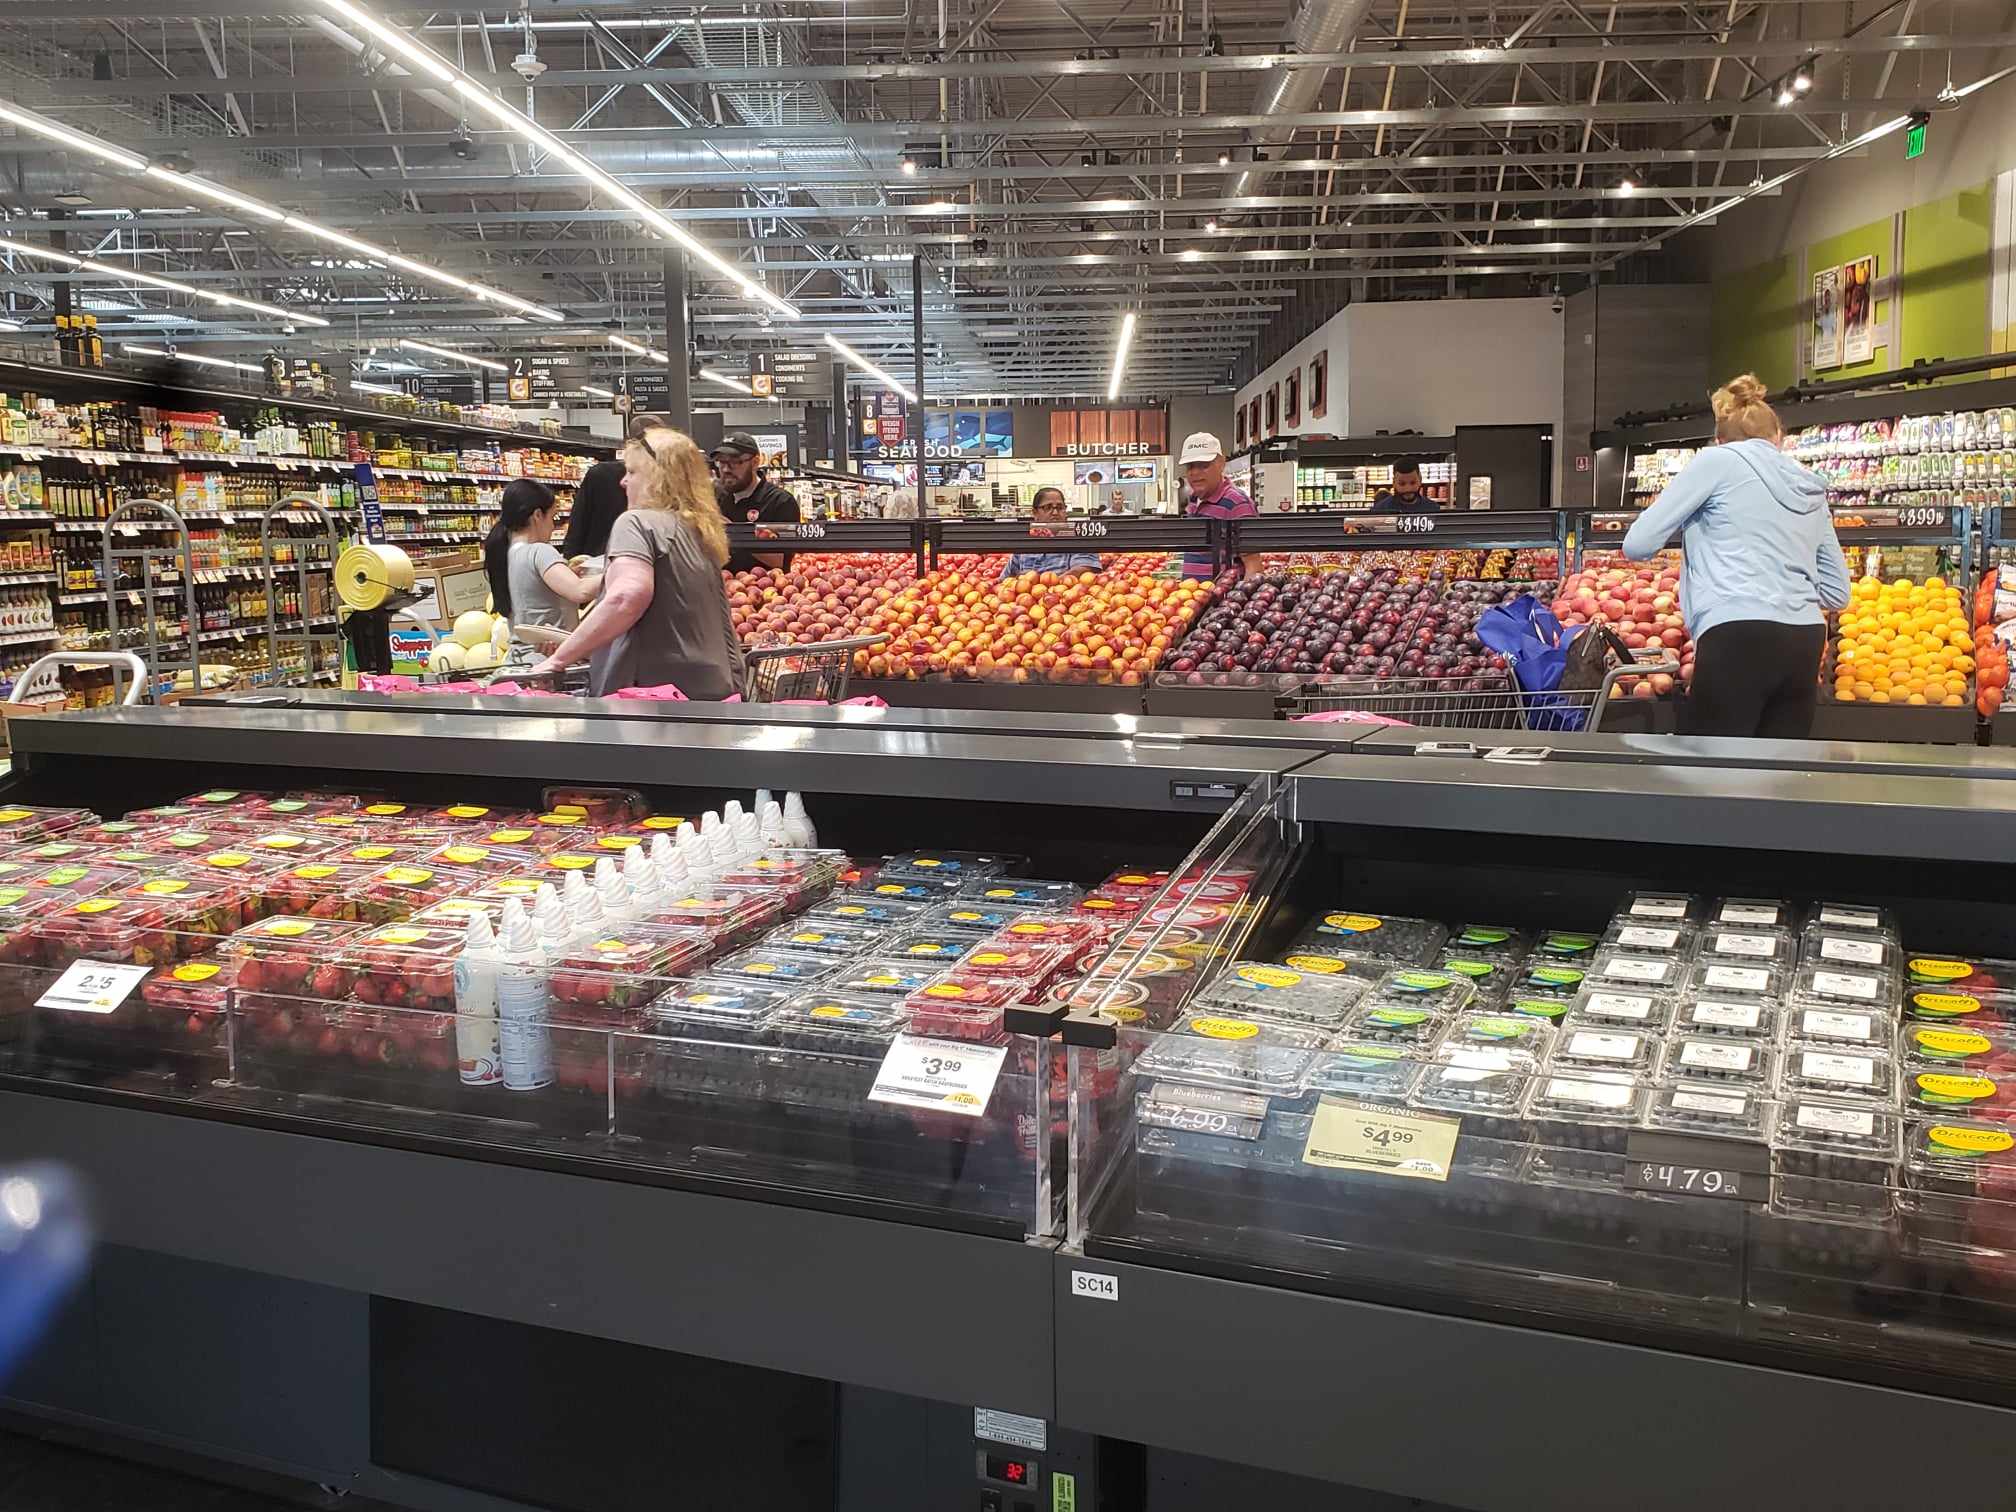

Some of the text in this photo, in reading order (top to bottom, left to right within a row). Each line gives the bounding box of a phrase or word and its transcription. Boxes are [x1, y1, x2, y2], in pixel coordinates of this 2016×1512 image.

[294, 359, 308, 367] SODA
[532, 358, 548, 366] SUGAR
[553, 358, 569, 366] SPICES
[758, 354, 765, 372] 1
[774, 353, 817, 361] SALAD DRESSINGS
[514, 358, 523, 376] 2
[775, 364, 805, 372] CONDIMENTS
[404, 378, 419, 394] 10
[618, 376, 626, 393] 9
[776, 375, 804, 383] COOKING OIL
[866, 404, 873, 418] 8
[903, 439, 938, 447] FRSH
[1067, 442, 1150, 456] BUTCHER
[78, 975, 94, 988] 2
[1922, 1076, 1991, 1089] Driscoll's
[1172, 1087, 1221, 1101] Blueberries
[1359, 1102, 1421, 1118] ORGANIC
[1935, 1129, 2009, 1142] Driscoll's
[1642, 1163, 1737, 1194] $4.79 EA
[1077, 1276, 1113, 1294] SC14
[1007, 1462, 1025, 1480] 32
